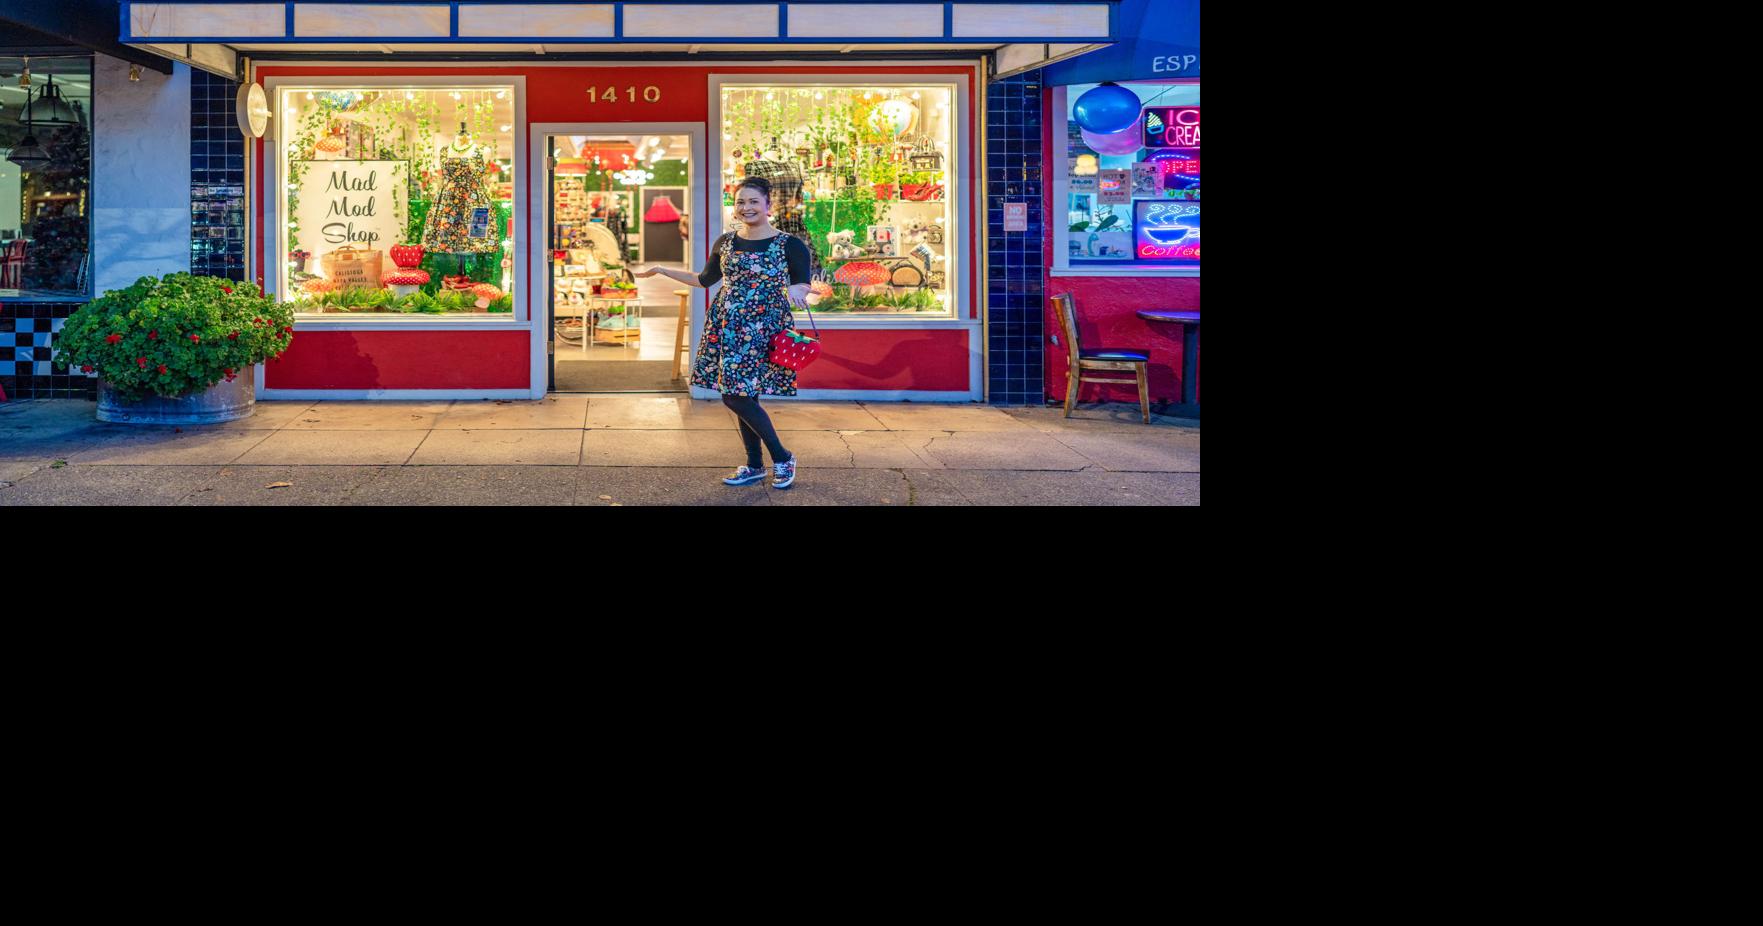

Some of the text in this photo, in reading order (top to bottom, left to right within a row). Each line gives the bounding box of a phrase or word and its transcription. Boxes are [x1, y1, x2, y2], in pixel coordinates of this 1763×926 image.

[1152, 54, 1200, 73] ESP
[586, 85, 661, 103] 1410
[325, 170, 378, 193] Mad
[325, 195, 377, 219] Mod
[321, 221, 380, 247] Shop
